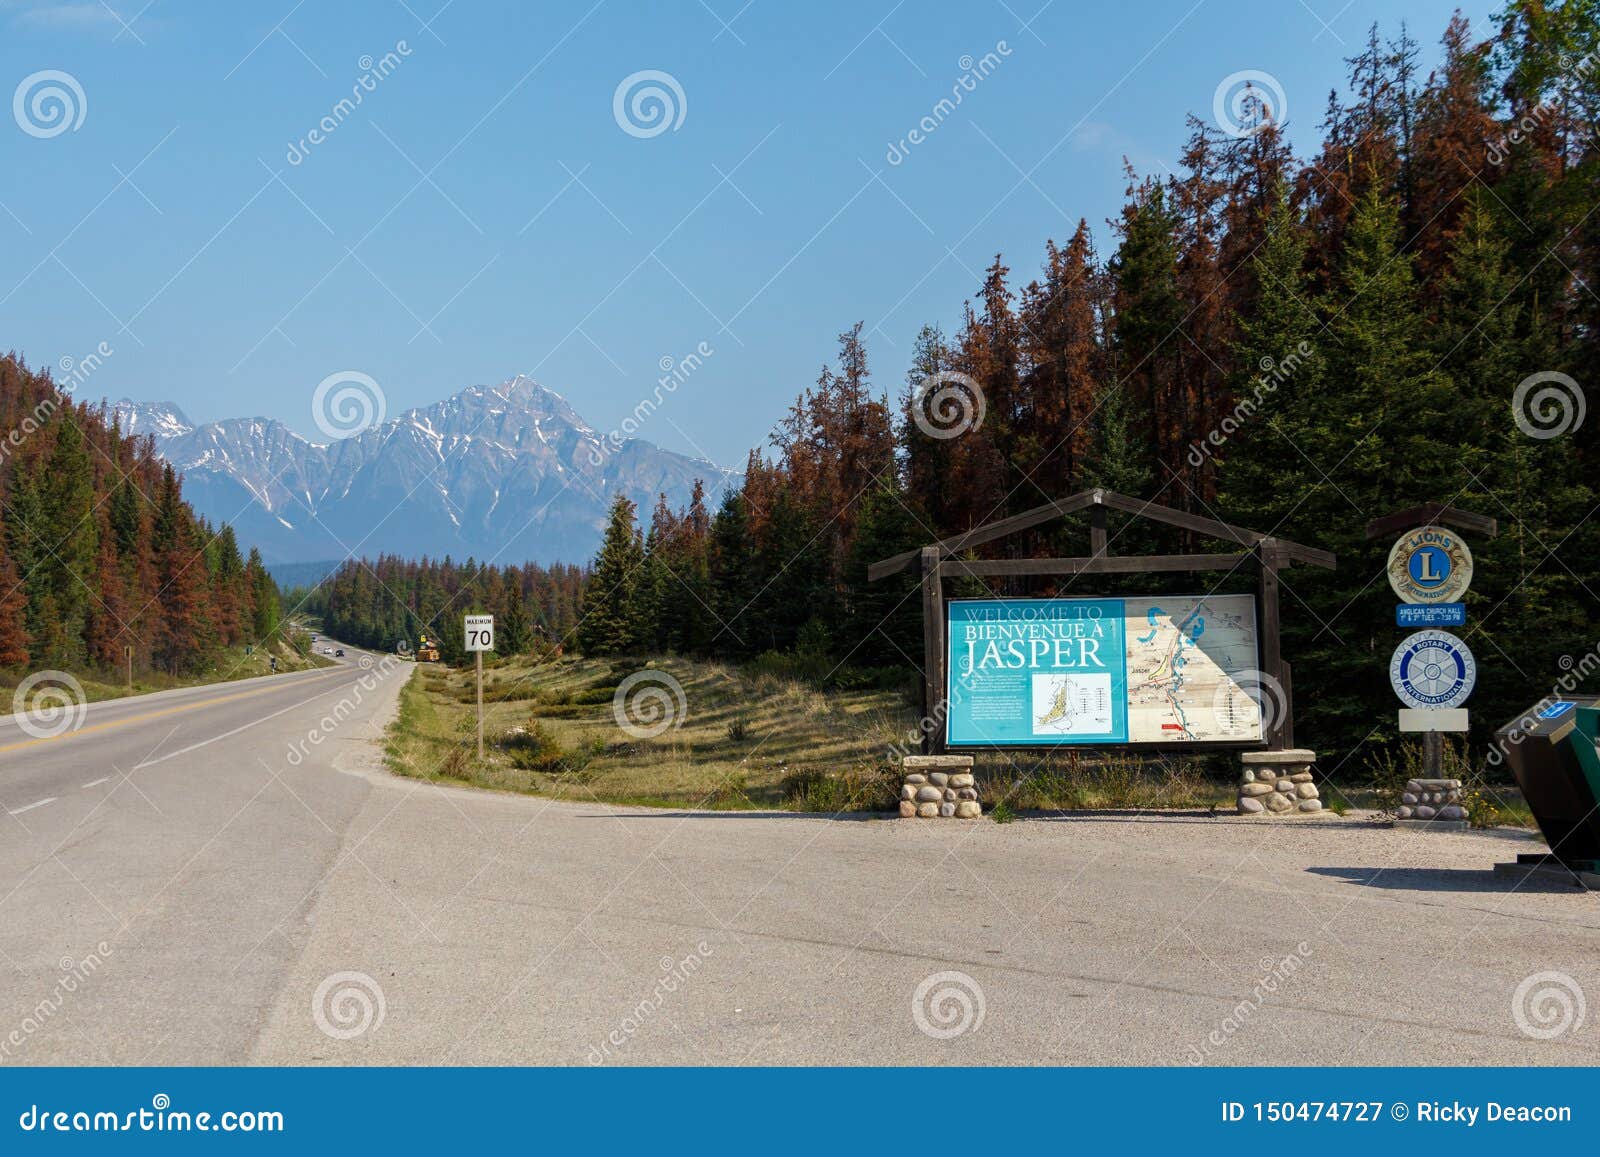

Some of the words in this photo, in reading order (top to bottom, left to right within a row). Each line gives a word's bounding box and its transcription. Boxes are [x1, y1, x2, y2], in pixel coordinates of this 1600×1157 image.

[1411, 532, 1451, 548] LIONS
[1419, 552, 1441, 581] L
[965, 606, 1068, 622] WELCOME
[1073, 606, 1103, 620] TO
[468, 630, 491, 646] 70
[966, 624, 1086, 640] BIENVENUE
[1416, 641, 1450, 650] ROTARY
[961, 638, 1106, 677] JASPER
[1405, 683, 1462, 704] INTERNATIONAL
